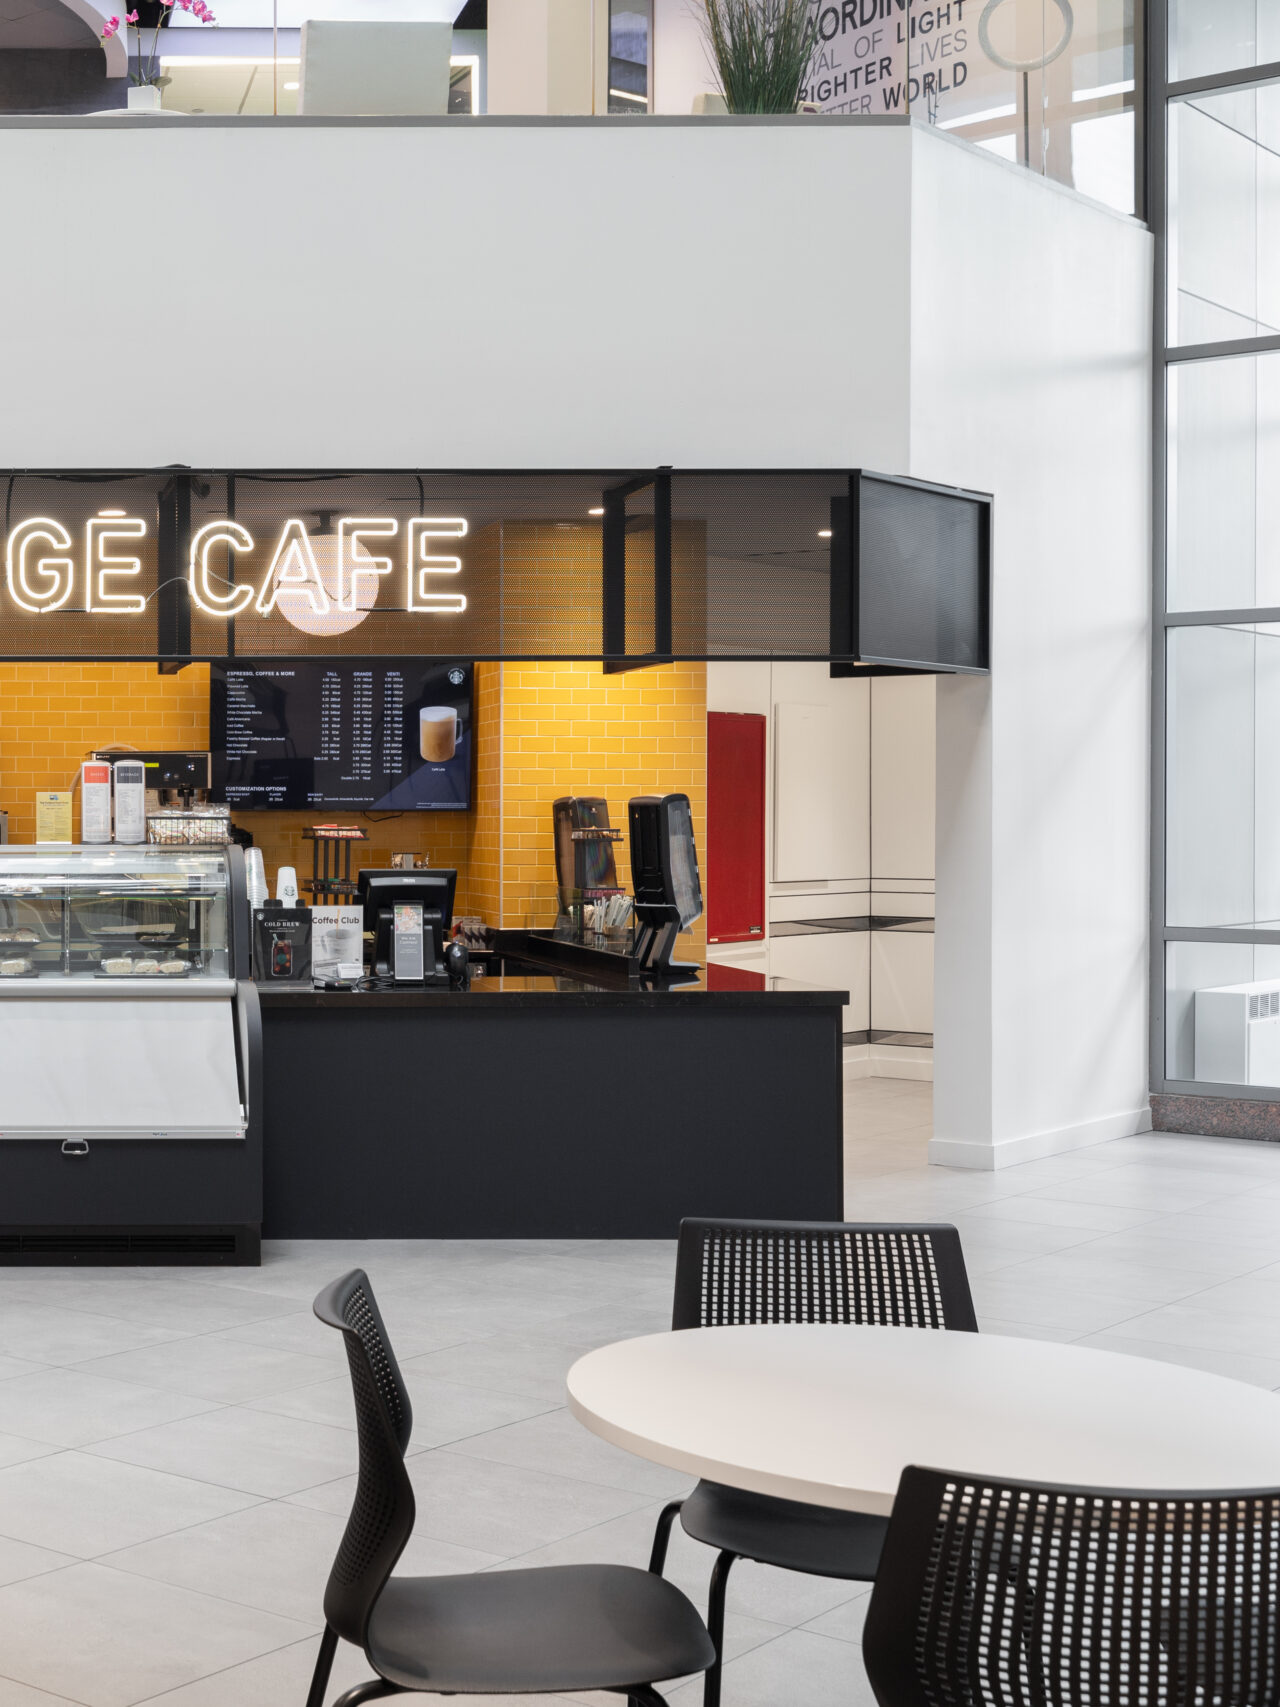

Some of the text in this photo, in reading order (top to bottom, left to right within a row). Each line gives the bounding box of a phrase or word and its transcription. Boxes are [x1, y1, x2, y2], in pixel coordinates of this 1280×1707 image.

[854, 28, 884, 59] OF
[896, 0, 967, 44] LIGHT
[798, 56, 893, 102] RIGHTER
[882, 61, 968, 110] WORLD
[188, 517, 469, 617] CAFE
[312, 916, 360, 924] Coffee Club
